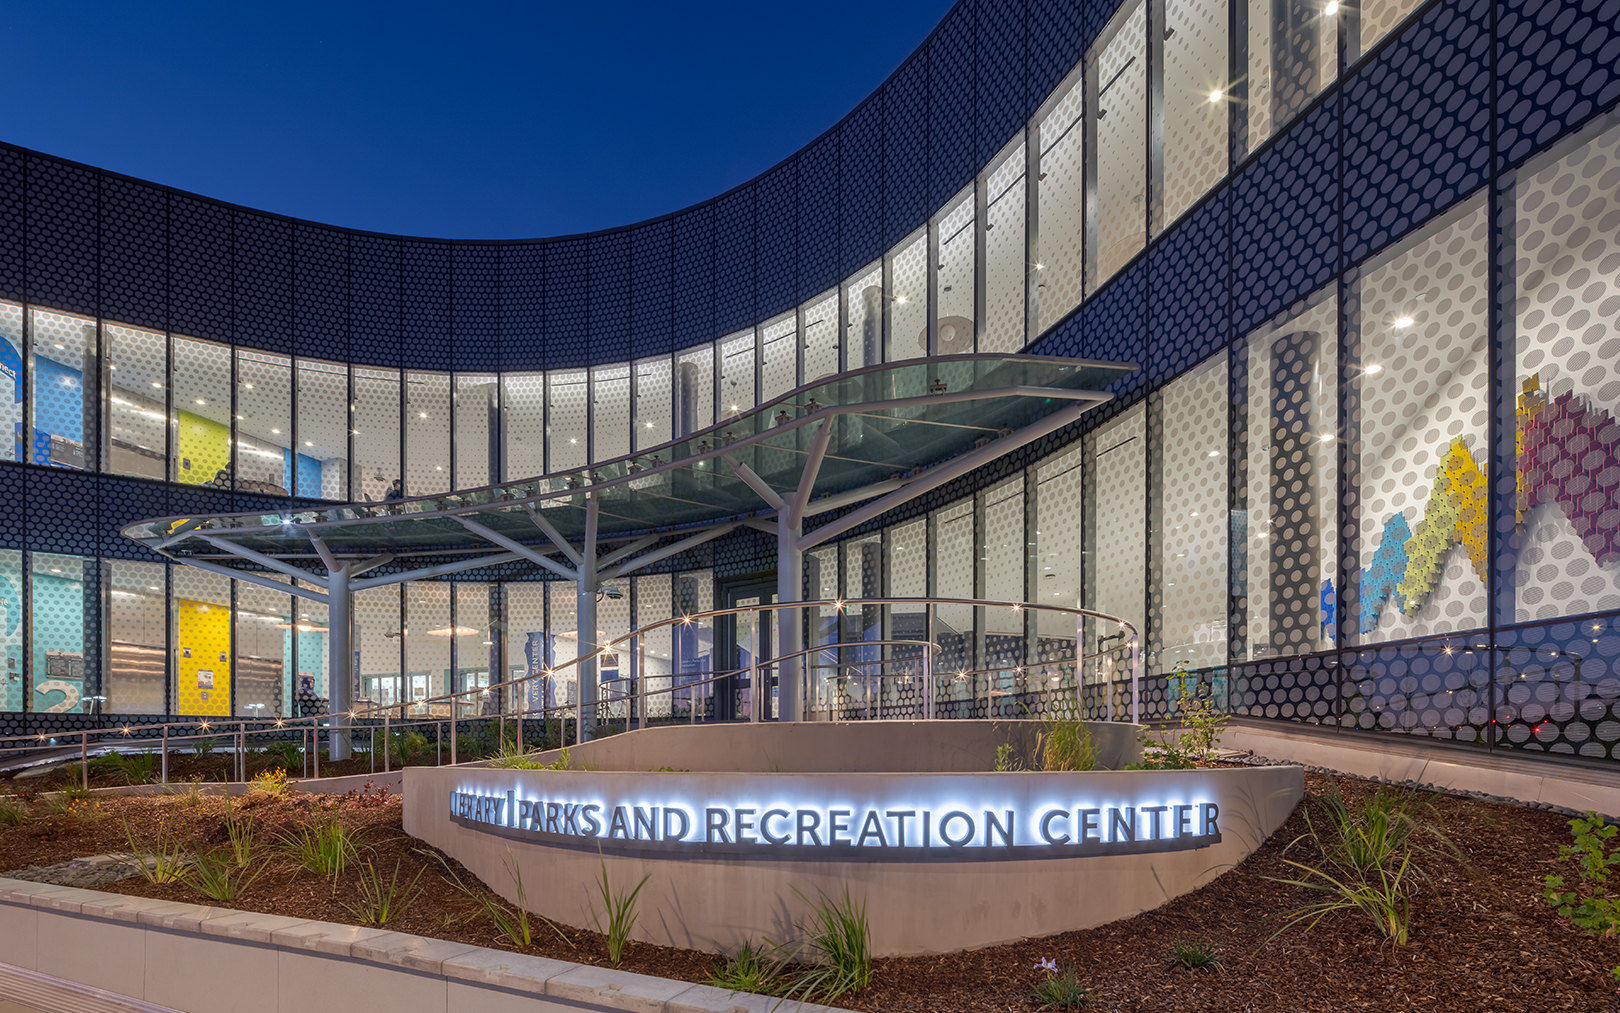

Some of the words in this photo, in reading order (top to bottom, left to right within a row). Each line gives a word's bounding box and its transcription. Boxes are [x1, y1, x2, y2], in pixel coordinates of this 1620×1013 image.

[450, 791, 505, 825] LIBRARY
[516, 800, 601, 837] PARKS
[608, 806, 691, 843] AND
[706, 807, 1014, 847] RECREATION
[1039, 803, 1220, 846] CENTER
